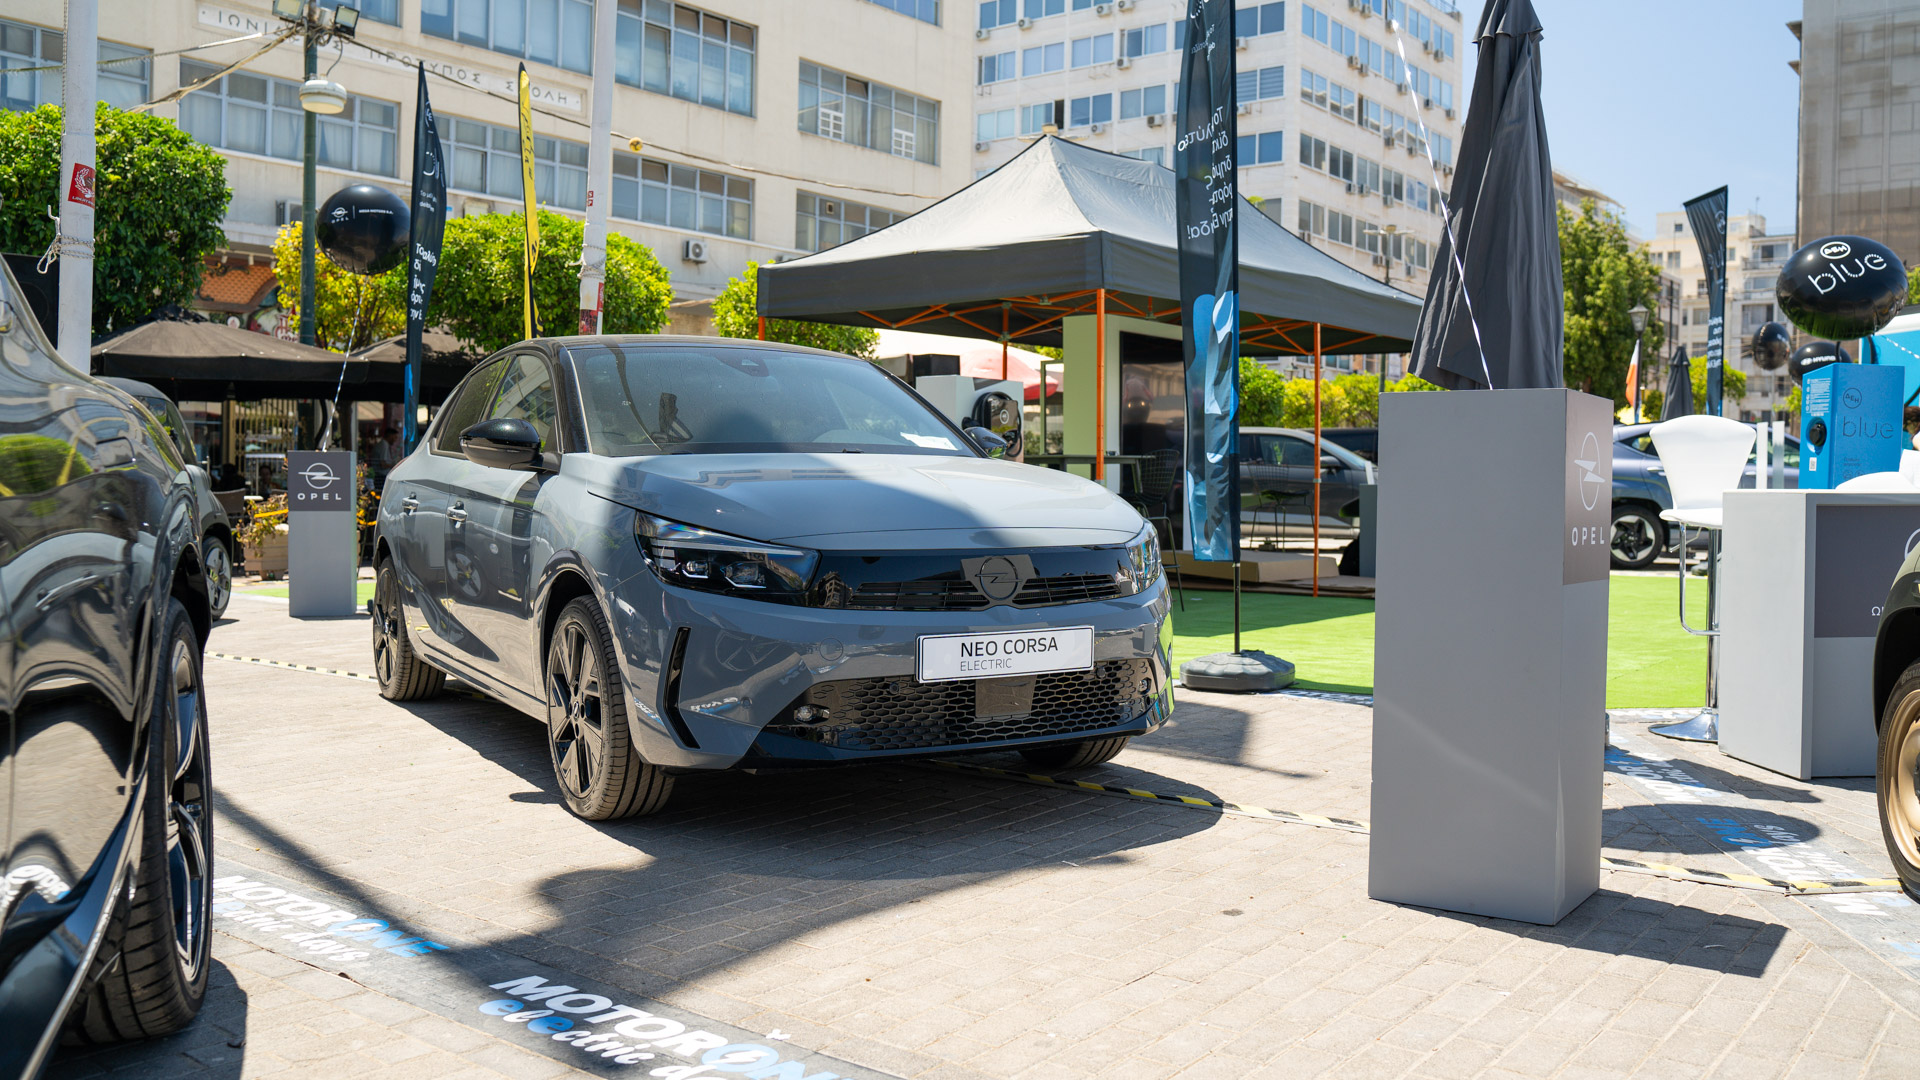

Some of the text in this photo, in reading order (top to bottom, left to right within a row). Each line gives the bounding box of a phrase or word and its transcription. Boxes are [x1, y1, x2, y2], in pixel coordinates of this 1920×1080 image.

[506, 80, 568, 104] ΣΟΛΗ
[1808, 253, 1887, 295] blue
[1843, 416, 1894, 439] blue
[1571, 527, 1605, 546] OPEL
[961, 637, 1058, 658] NEO CORSA
[960, 658, 1012, 671] ELECTRIC
[478, 999, 655, 1065] electric
